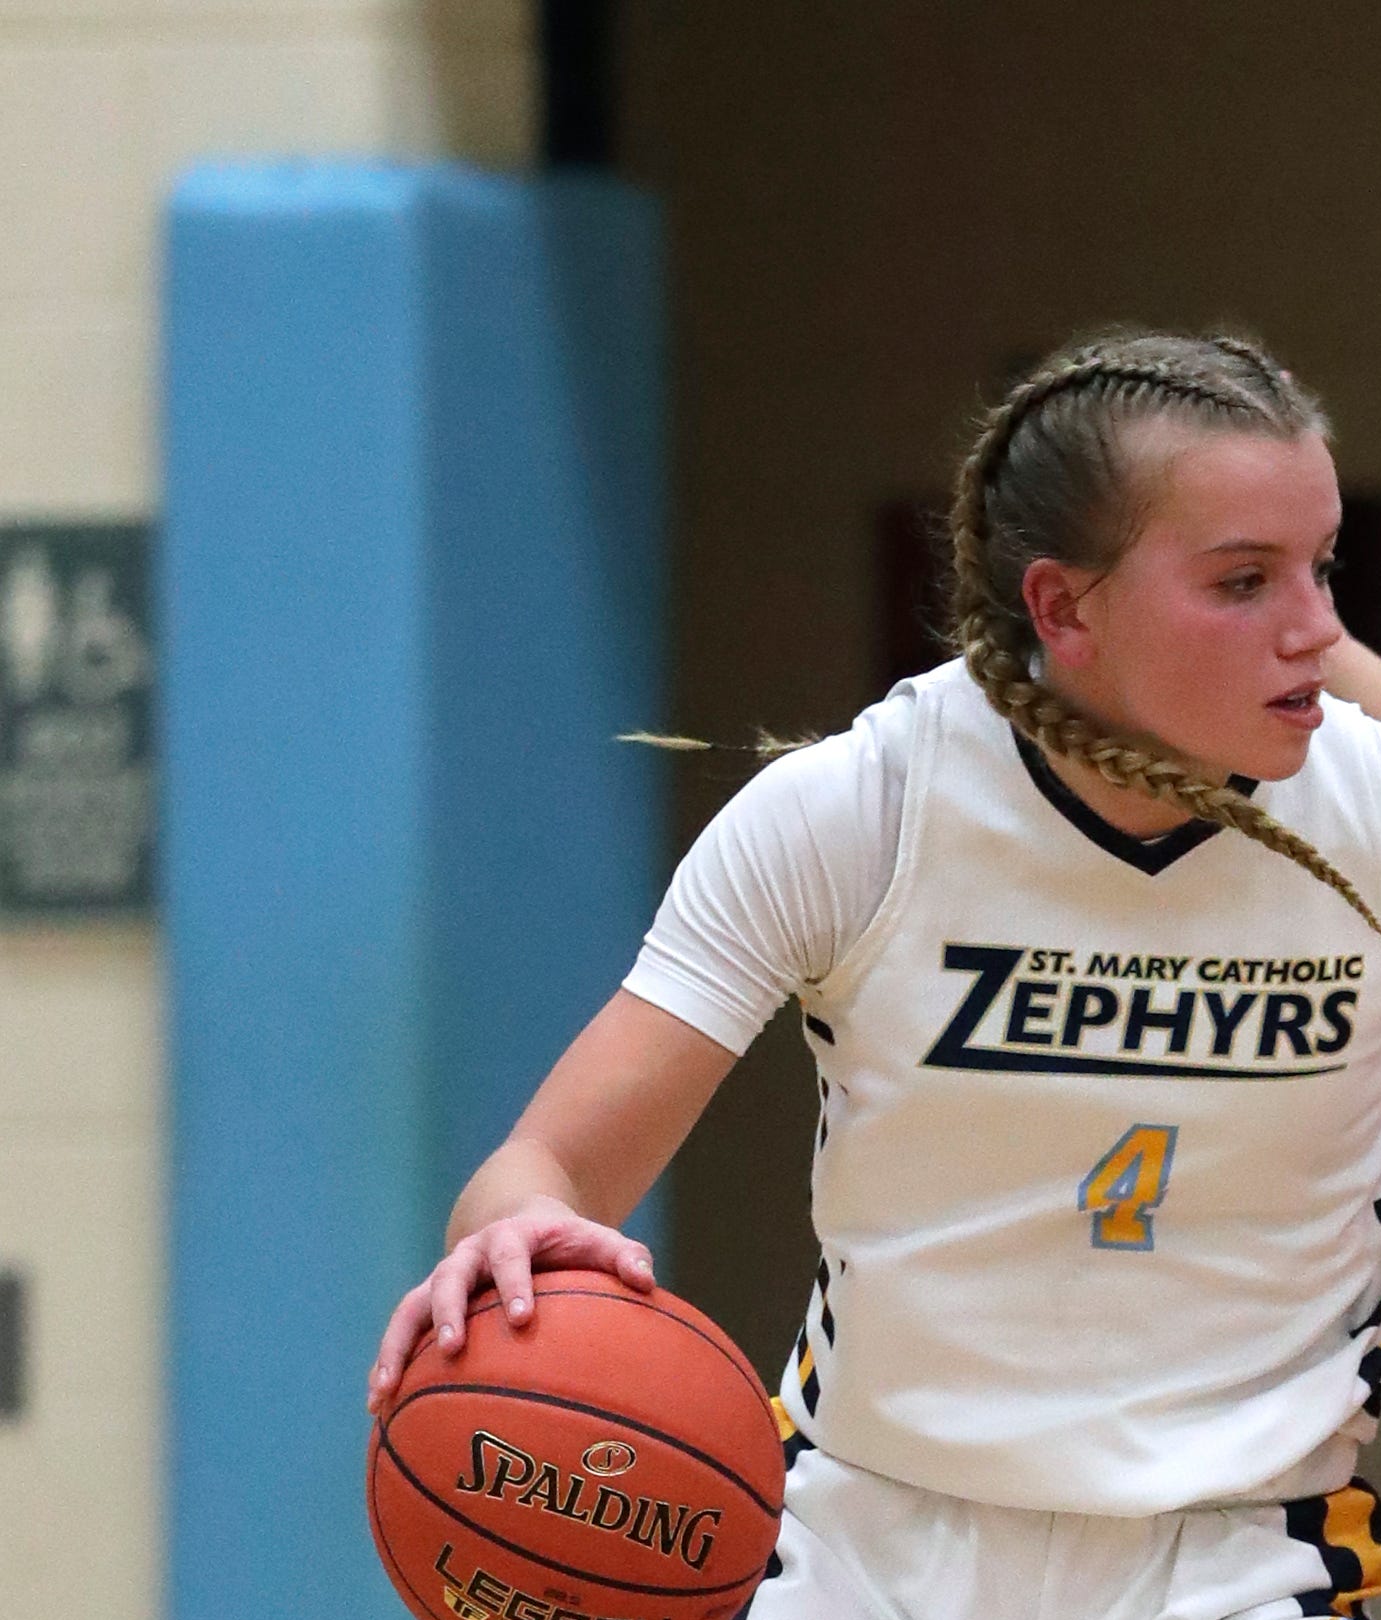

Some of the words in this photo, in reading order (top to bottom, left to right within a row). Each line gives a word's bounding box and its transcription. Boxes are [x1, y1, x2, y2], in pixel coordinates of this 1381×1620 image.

[919, 941, 1361, 1079] ZEPHYRS
[1029, 949, 1076, 975] ST.
[1088, 953, 1189, 982] MARY
[1197, 954, 1364, 985] CATHOLIC
[1076, 1122, 1180, 1252] 4
[455, 1430, 726, 1573] SPALDING
